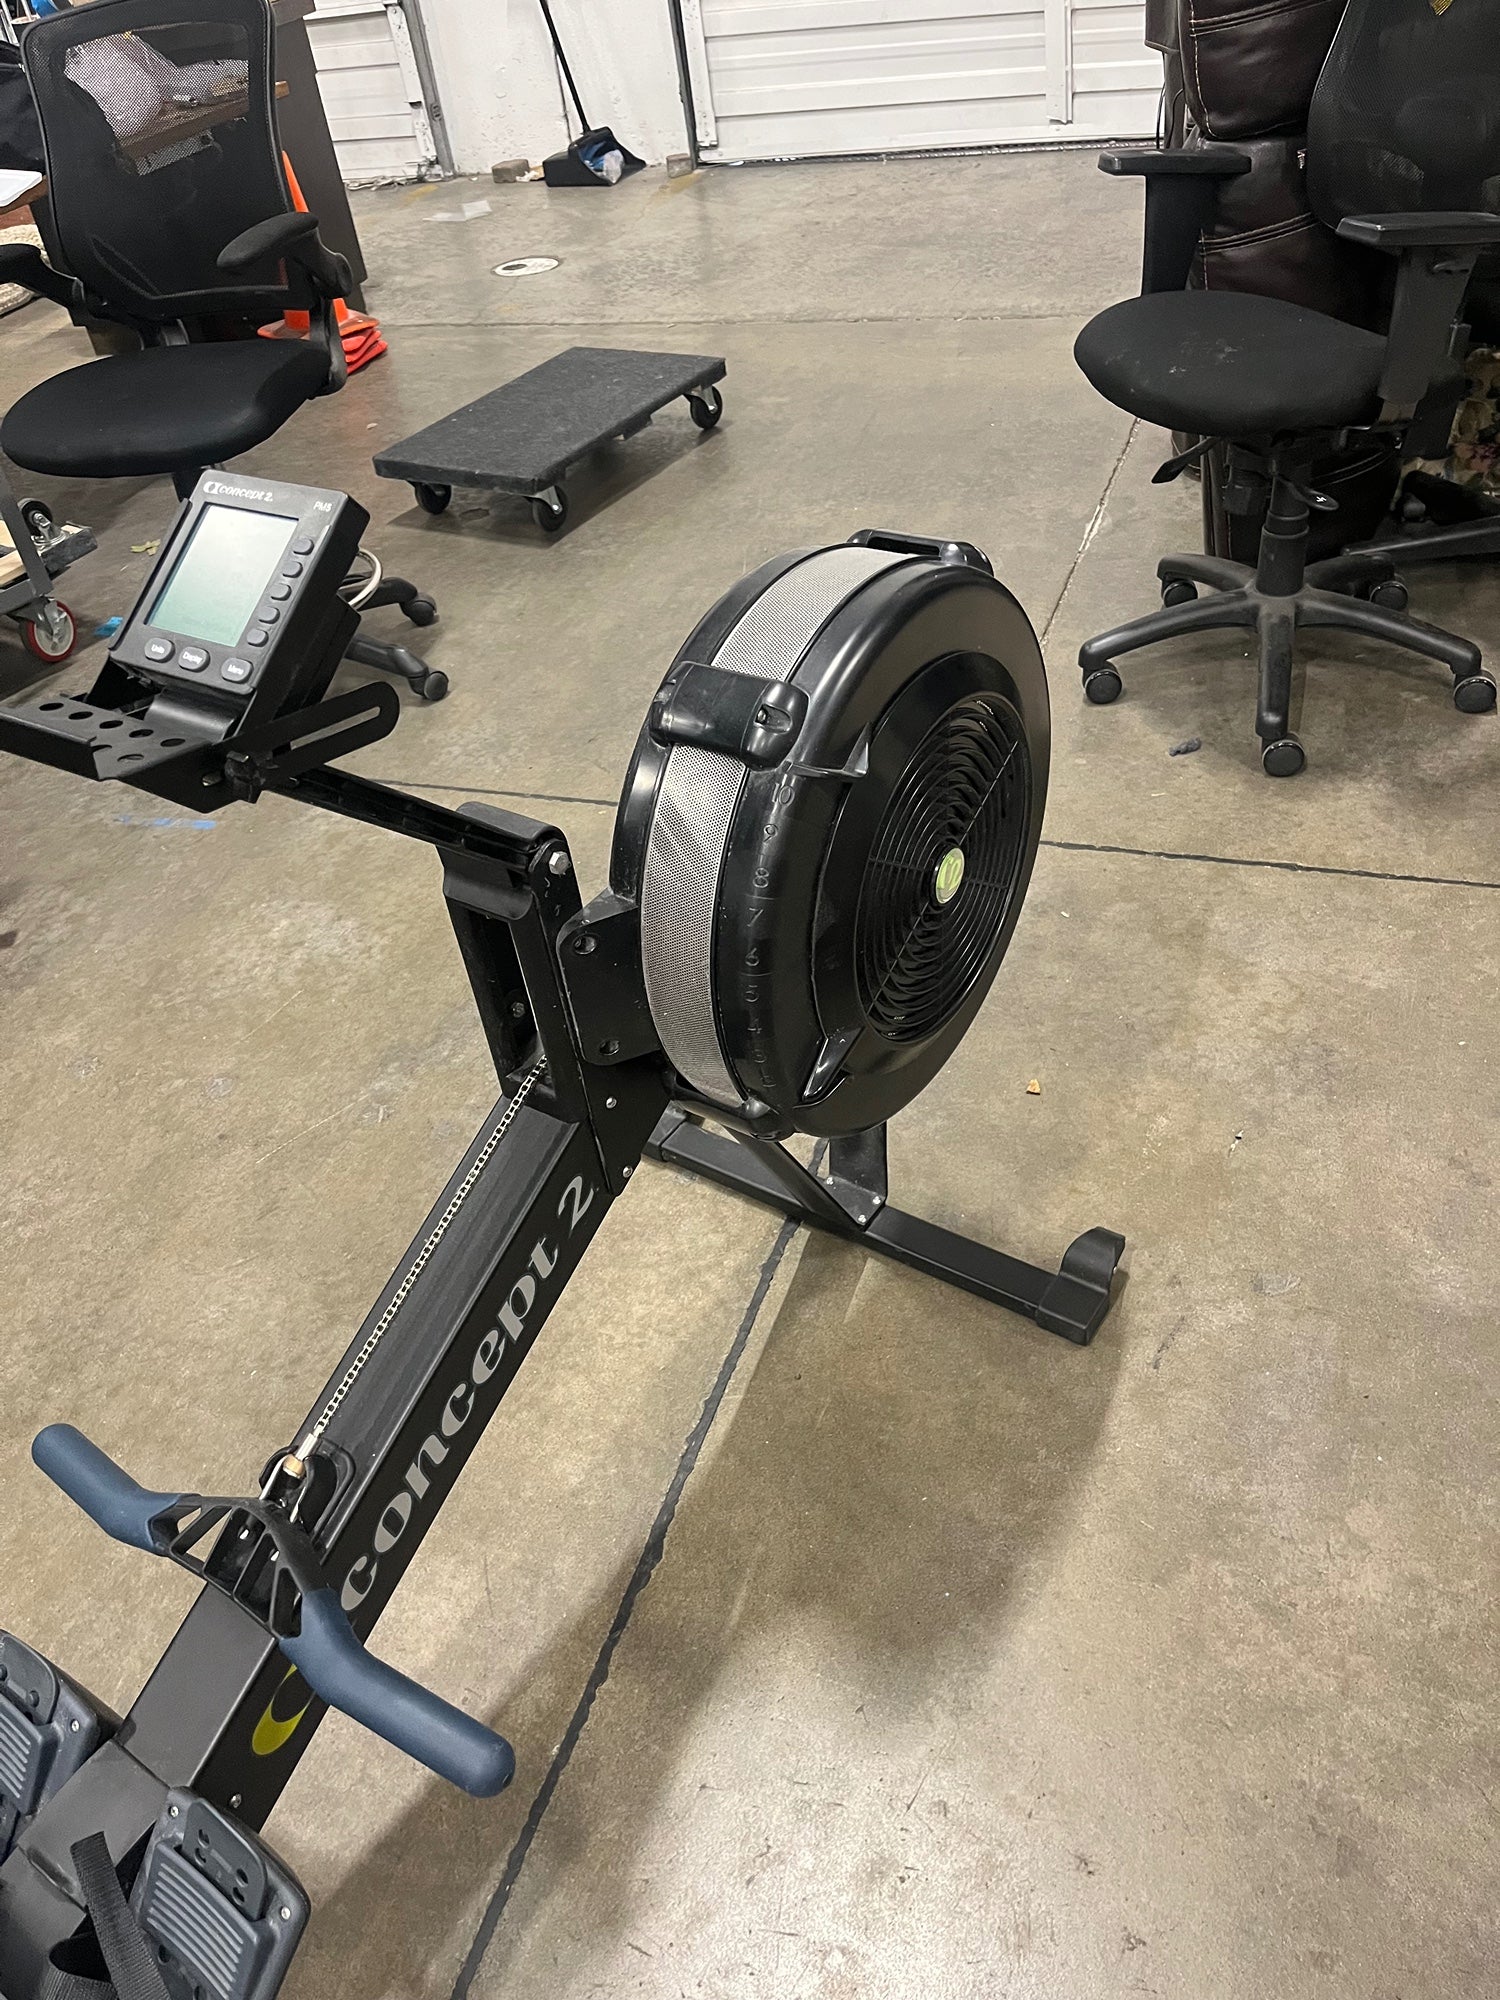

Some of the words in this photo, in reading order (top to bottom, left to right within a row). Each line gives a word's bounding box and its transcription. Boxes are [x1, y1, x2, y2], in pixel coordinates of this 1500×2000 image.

[219, 484, 264, 500] concept
[313, 501, 332, 512] PM5
[182, 652, 202, 664] Display
[228, 664, 244, 675] Menu
[772, 782, 795, 806] 10
[762, 823, 778, 843] 9
[752, 867, 770, 889] 8
[747, 906, 765, 927] 7
[745, 947, 760, 968] 6
[341, 1236, 558, 1611] concept
[558, 1174, 595, 1230] 2
